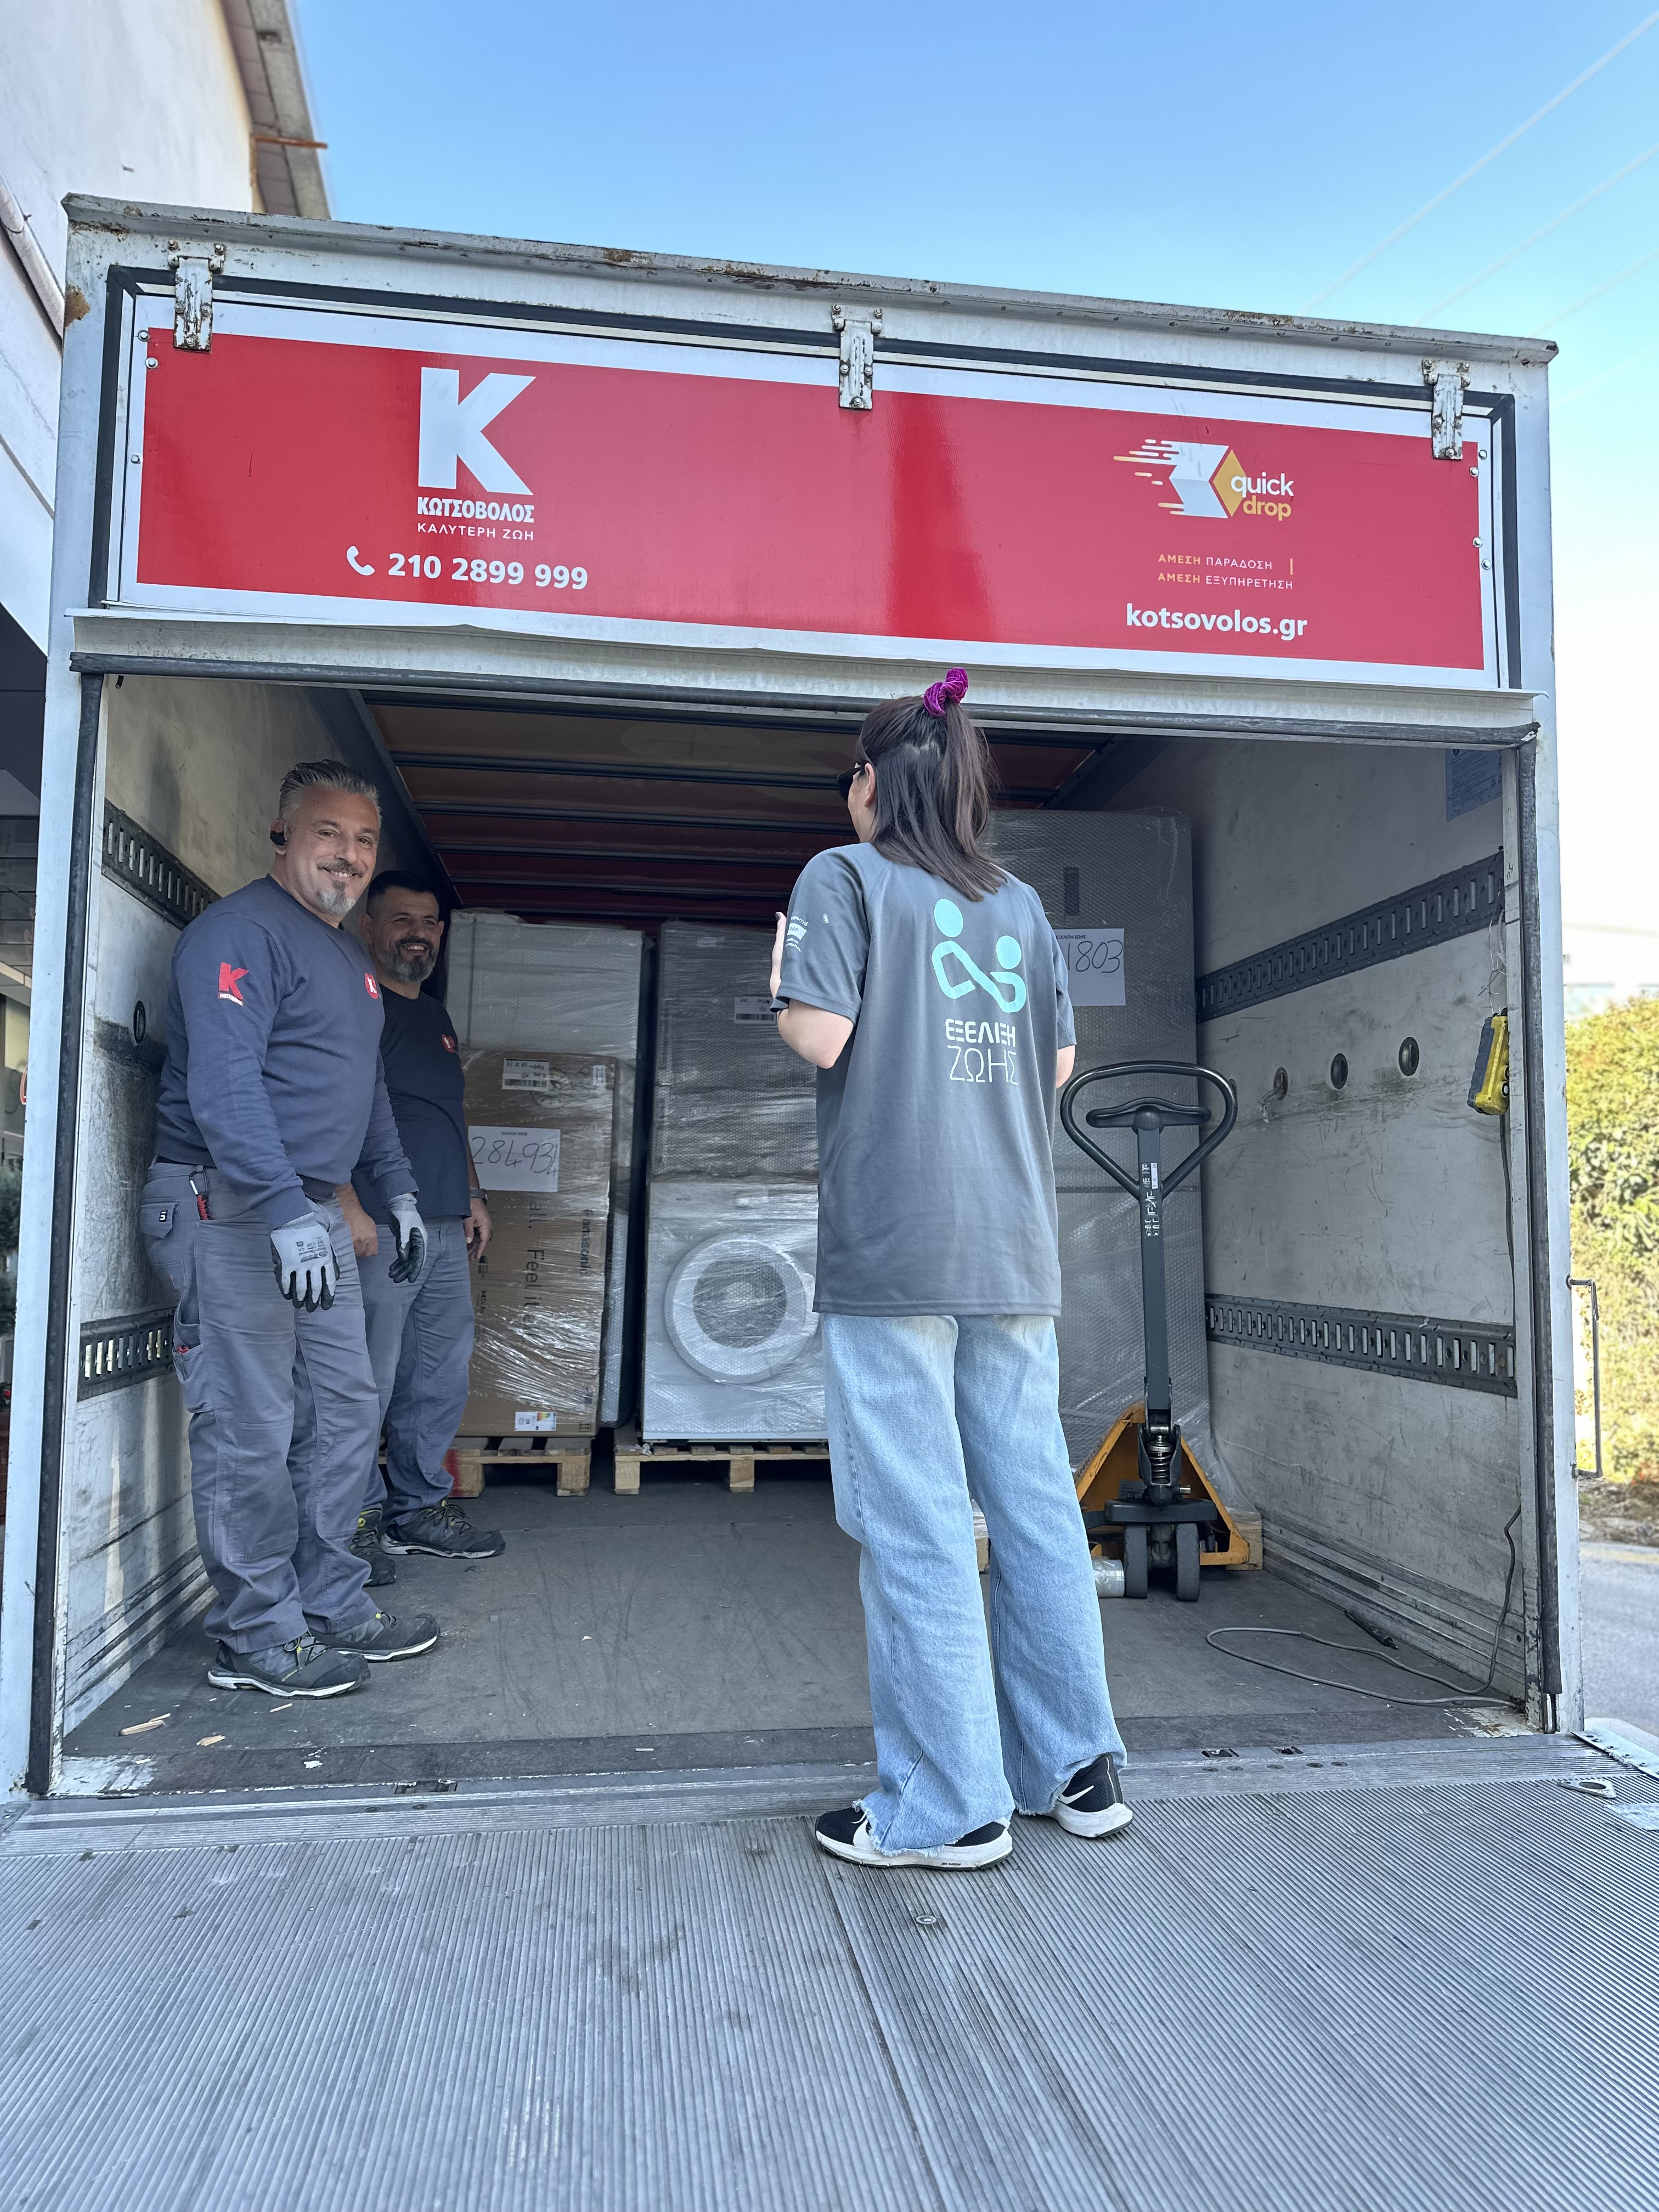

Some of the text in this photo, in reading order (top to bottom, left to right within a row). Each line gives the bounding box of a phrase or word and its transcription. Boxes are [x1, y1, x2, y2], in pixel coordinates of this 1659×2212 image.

[1231, 471, 1295, 498] quick
[417, 496, 534, 523] ΚΩΤΣΟΒΟΛΟΣ
[1243, 495, 1292, 522] drop
[417, 522, 534, 541] ΚΑΛΥΤΕΡΗ ΖΩΗ
[387, 552, 588, 590] 210 2899 999
[1158, 554, 1273, 570] ΑΜΕΣΗ ΠΑΡΑΔΟΣΗ
[1157, 572, 1293, 590] ΑΜΕΣΗ ΕΞΥΠΗΡΕΤΗΣΗ
[1126, 602, 1308, 641] kotsovolos.gr
[945, 1018, 1015, 1047] ΕΞΕΛΙΞΗ
[947, 1045, 1019, 1086] ΖΩΗΣ
[524, 1249, 545, 1289] Feel
[524, 1296, 542, 1308] it
